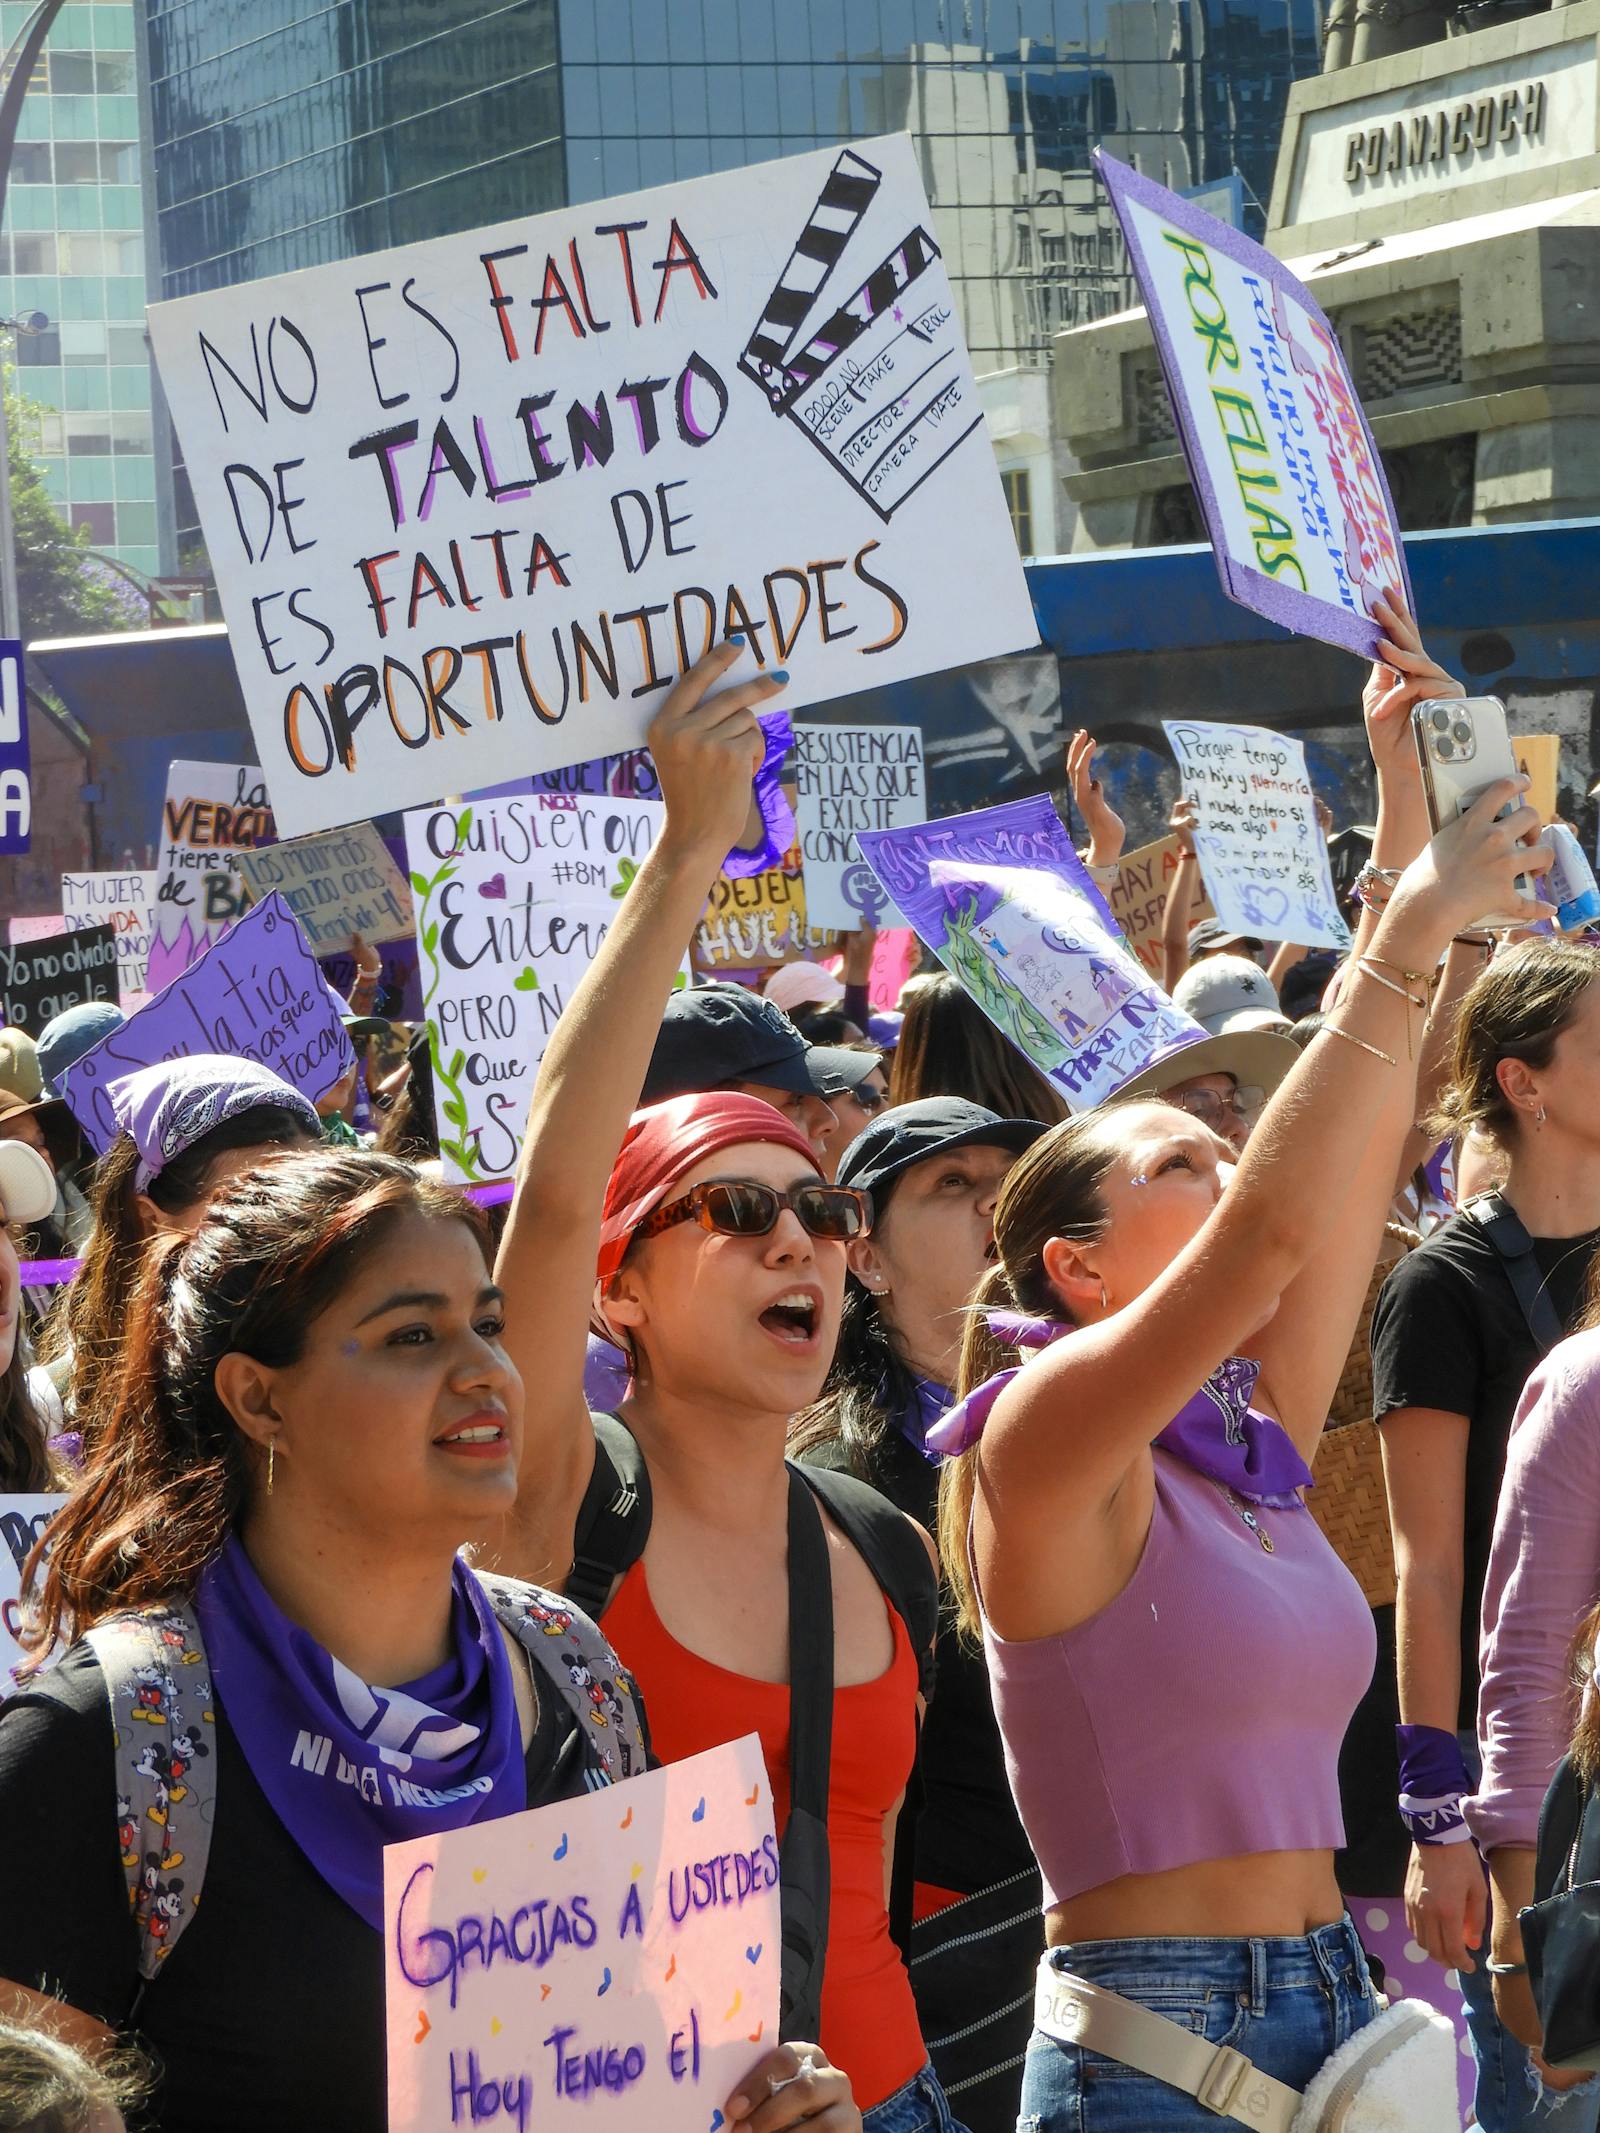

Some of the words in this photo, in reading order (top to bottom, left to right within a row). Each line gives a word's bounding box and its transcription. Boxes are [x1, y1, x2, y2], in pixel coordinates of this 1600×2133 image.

[1343, 82, 1547, 183] COANACOCH
[199, 315, 318, 434] NO
[355, 278, 460, 411] ES
[478, 217, 718, 362] FALTA
[1162, 230, 1239, 374] POR
[819, 399, 854, 440] SCENE
[858, 354, 895, 392] TAKE
[224, 457, 318, 564] DE
[348, 350, 730, 534] TALENTO
[843, 405, 904, 467] DIRECTOR
[1242, 276, 1288, 376] para
[1282, 388, 1304, 437] no
[1299, 447, 1356, 615] marchar
[868, 434, 919, 493] CAMERA
[1212, 387, 1308, 592] ELLAS
[253, 588, 334, 676] ES
[356, 530, 571, 638] FALTA
[611, 481, 697, 575] DE
[282, 540, 910, 779] OPORTUNIDADES
[794, 731, 921, 764] RESISTENCIA
[1175, 729, 1236, 763] Porque
[1242, 738, 1287, 776] tengo
[796, 764, 822, 795] EN
[829, 765, 869, 797] LAS
[876, 765, 918, 797] QUE
[820, 798, 899, 830] EXISTE
[167, 845, 219, 868] tiene
[804, 830, 864, 863] CONC
[158, 872, 195, 906] de
[551, 860, 606, 888] #8M
[1111, 858, 1153, 909] HAY
[0, 944, 30, 986] Yo
[33, 955, 60, 980] no
[4, 992, 27, 1025] lo
[181, 988, 240, 1055] la
[281, 990, 315, 1035] que
[437, 994, 516, 1046] PERO
[465, 1052, 527, 1086] Que
[290, 1729, 333, 1776] NI
[396, 1862, 598, 2010] GRACIAS
[619, 1882, 644, 1939] A
[667, 1833, 780, 1924] USTEDES
[543, 2024, 646, 2098] TENGO
